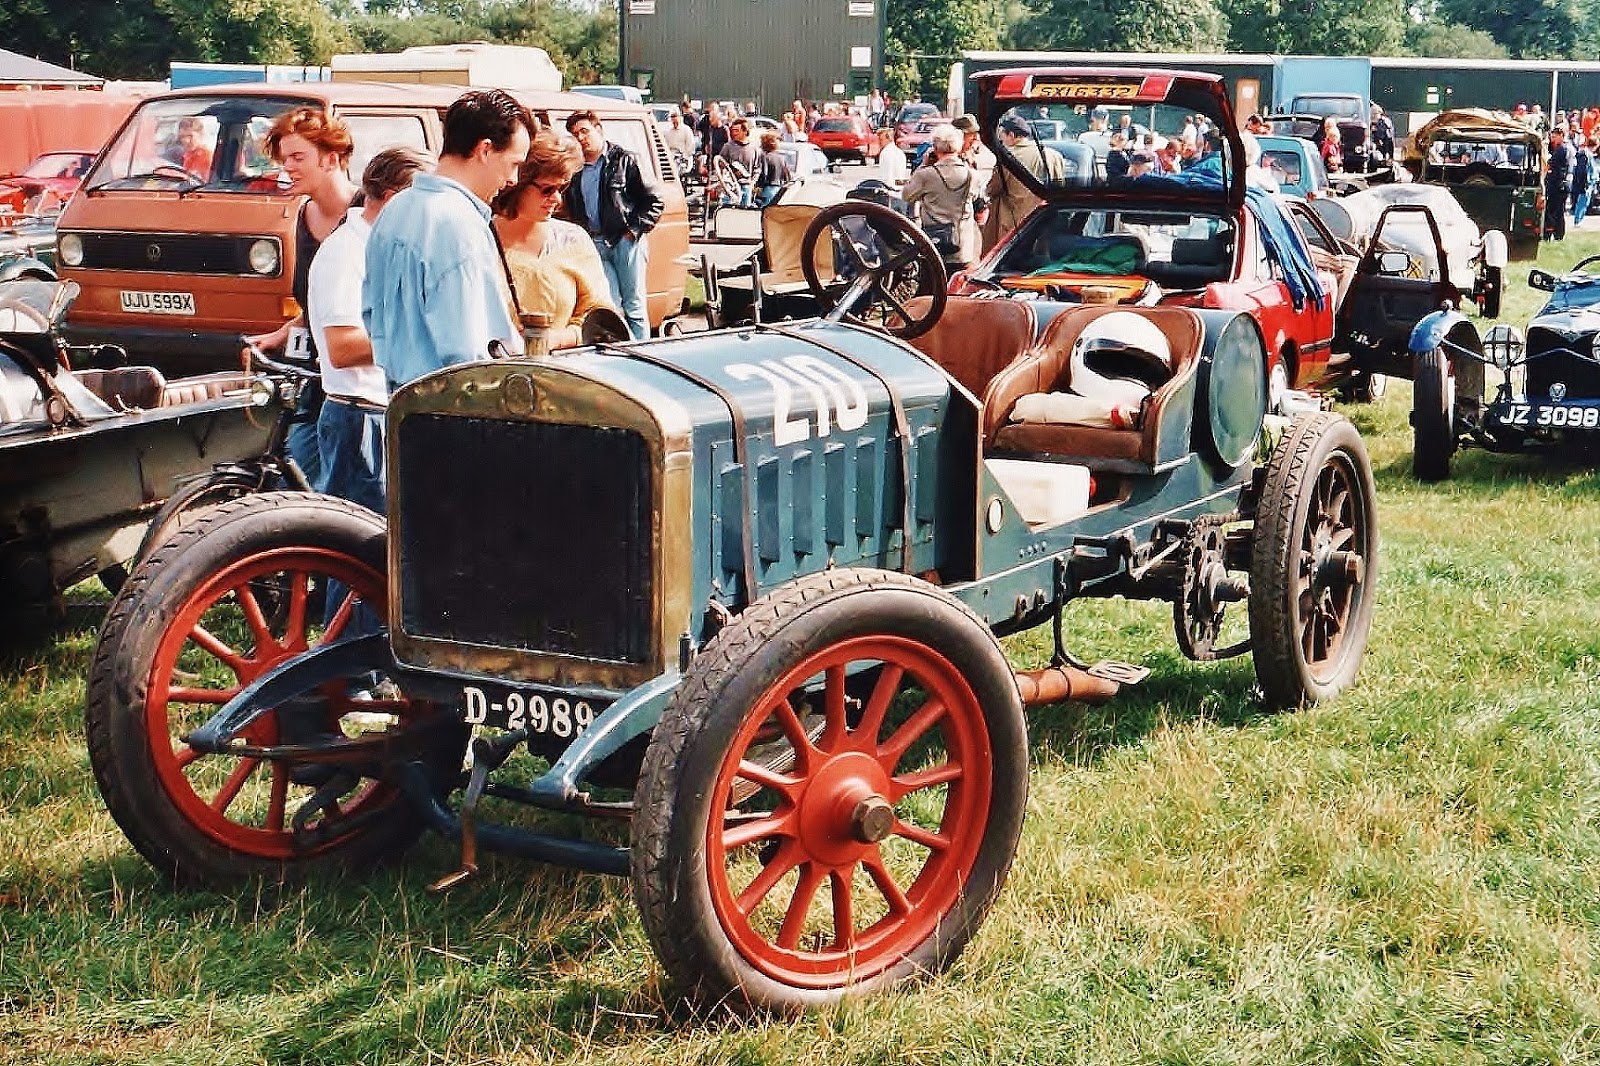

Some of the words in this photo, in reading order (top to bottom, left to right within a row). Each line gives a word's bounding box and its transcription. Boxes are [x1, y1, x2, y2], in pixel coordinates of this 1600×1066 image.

[122, 292, 150, 308] UJU
[153, 294, 193, 311] 599X
[724, 355, 868, 447] 210
[1500, 405, 1531, 424] JZ
[1537, 406, 1599, 427] 3098
[463, 686, 594, 738] D-2989
